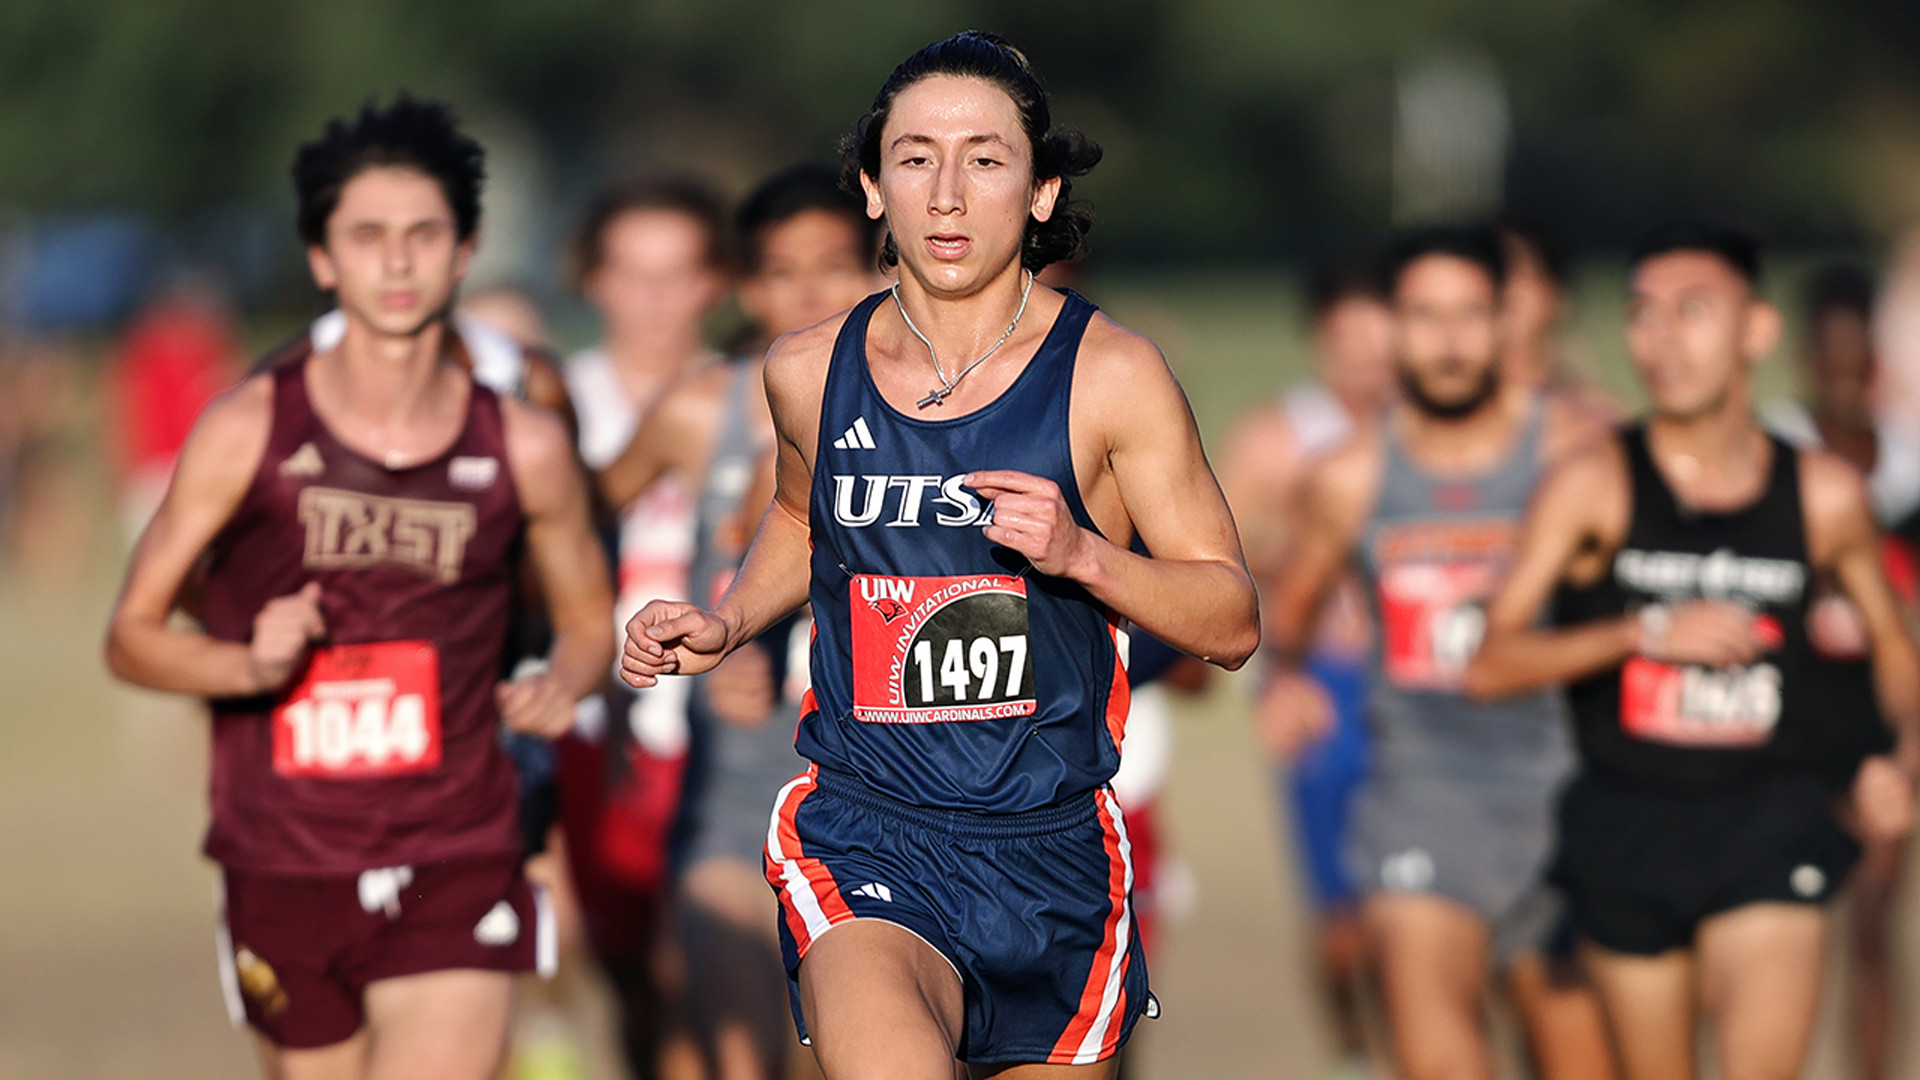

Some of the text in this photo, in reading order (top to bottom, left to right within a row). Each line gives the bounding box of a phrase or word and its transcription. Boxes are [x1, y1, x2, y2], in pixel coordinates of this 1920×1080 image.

[832, 474, 995, 527] UTS
[299, 487, 477, 584] TXST
[860, 577, 915, 603] UIW
[889, 578, 1002, 705] UIW INVITATIONAL
[914, 635, 1027, 702] 1497
[283, 694, 430, 768] 1044
[864, 704, 1026, 724] WWW.UIWCARDINALS.COM
